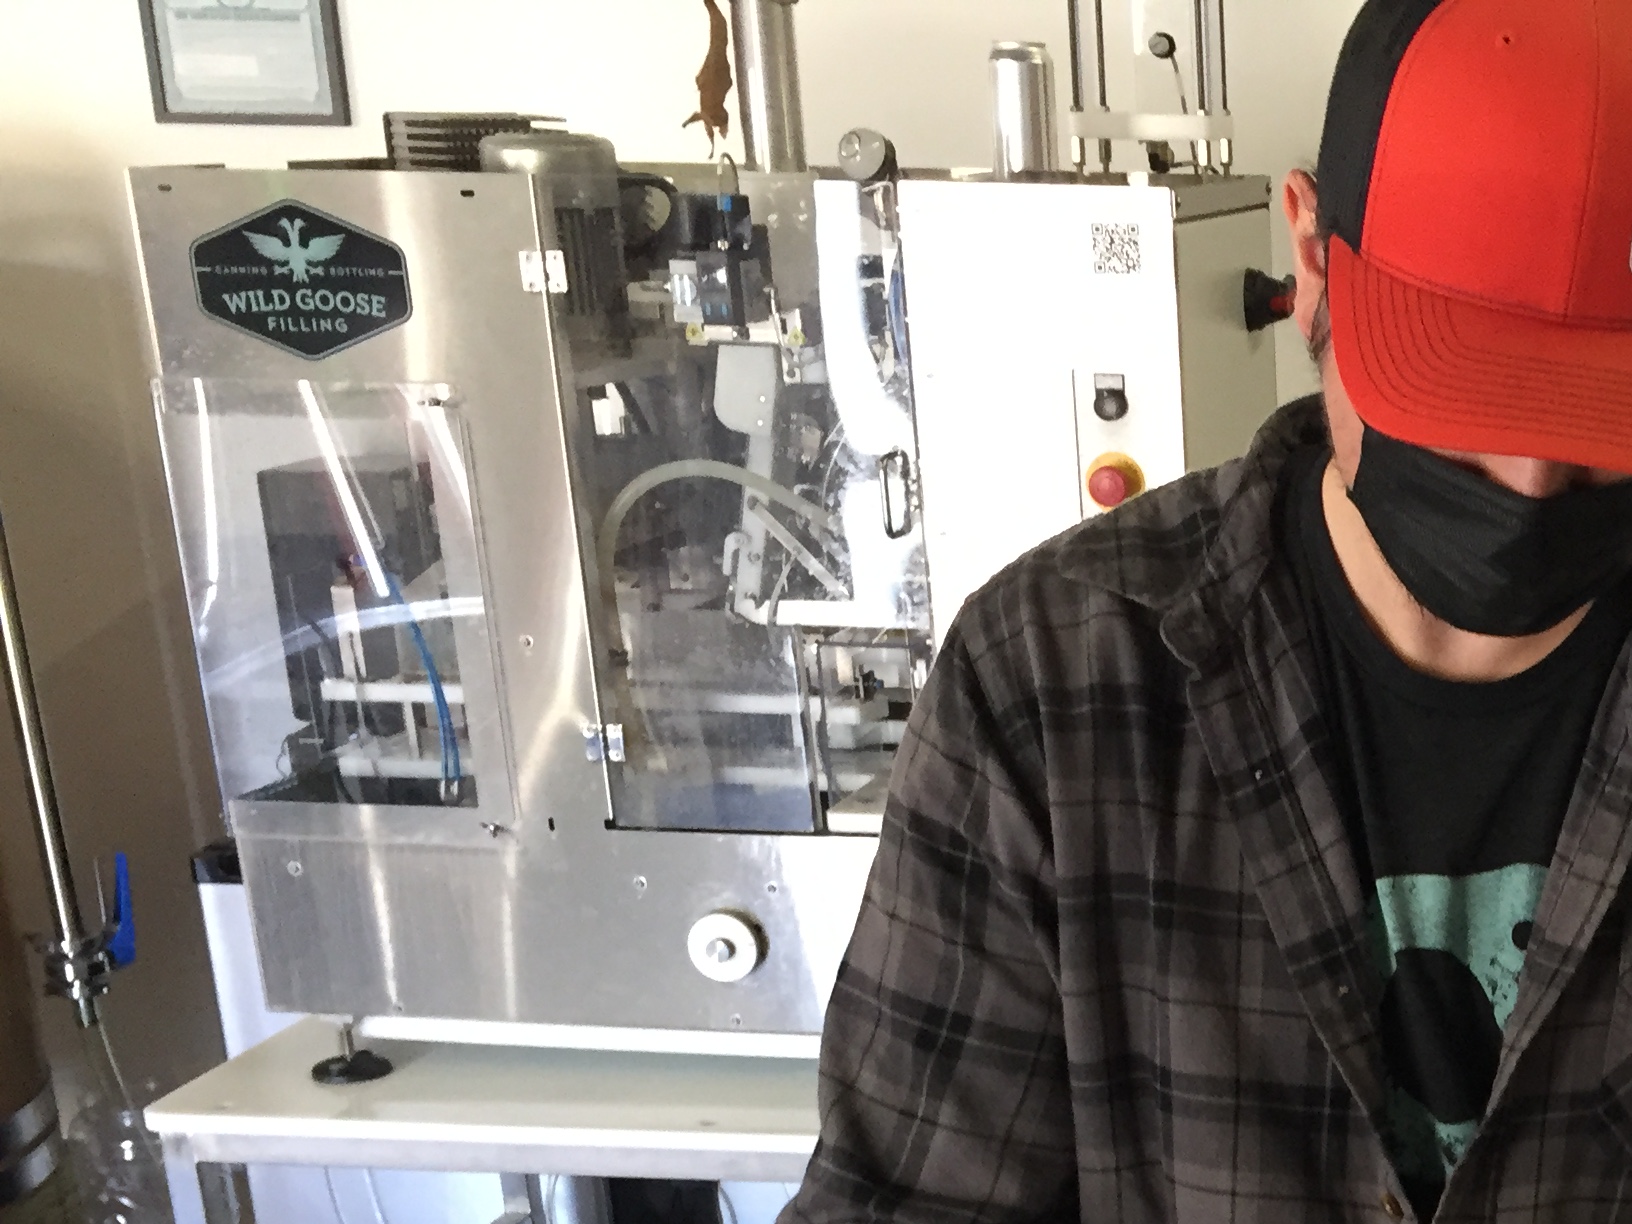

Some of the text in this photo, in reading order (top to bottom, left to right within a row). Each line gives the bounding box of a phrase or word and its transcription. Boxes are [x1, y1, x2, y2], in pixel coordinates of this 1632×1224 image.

[214, 264, 385, 279] CANNING BOTTLING
[222, 288, 386, 318] WILD GOOSE
[267, 316, 348, 334] FILLING
